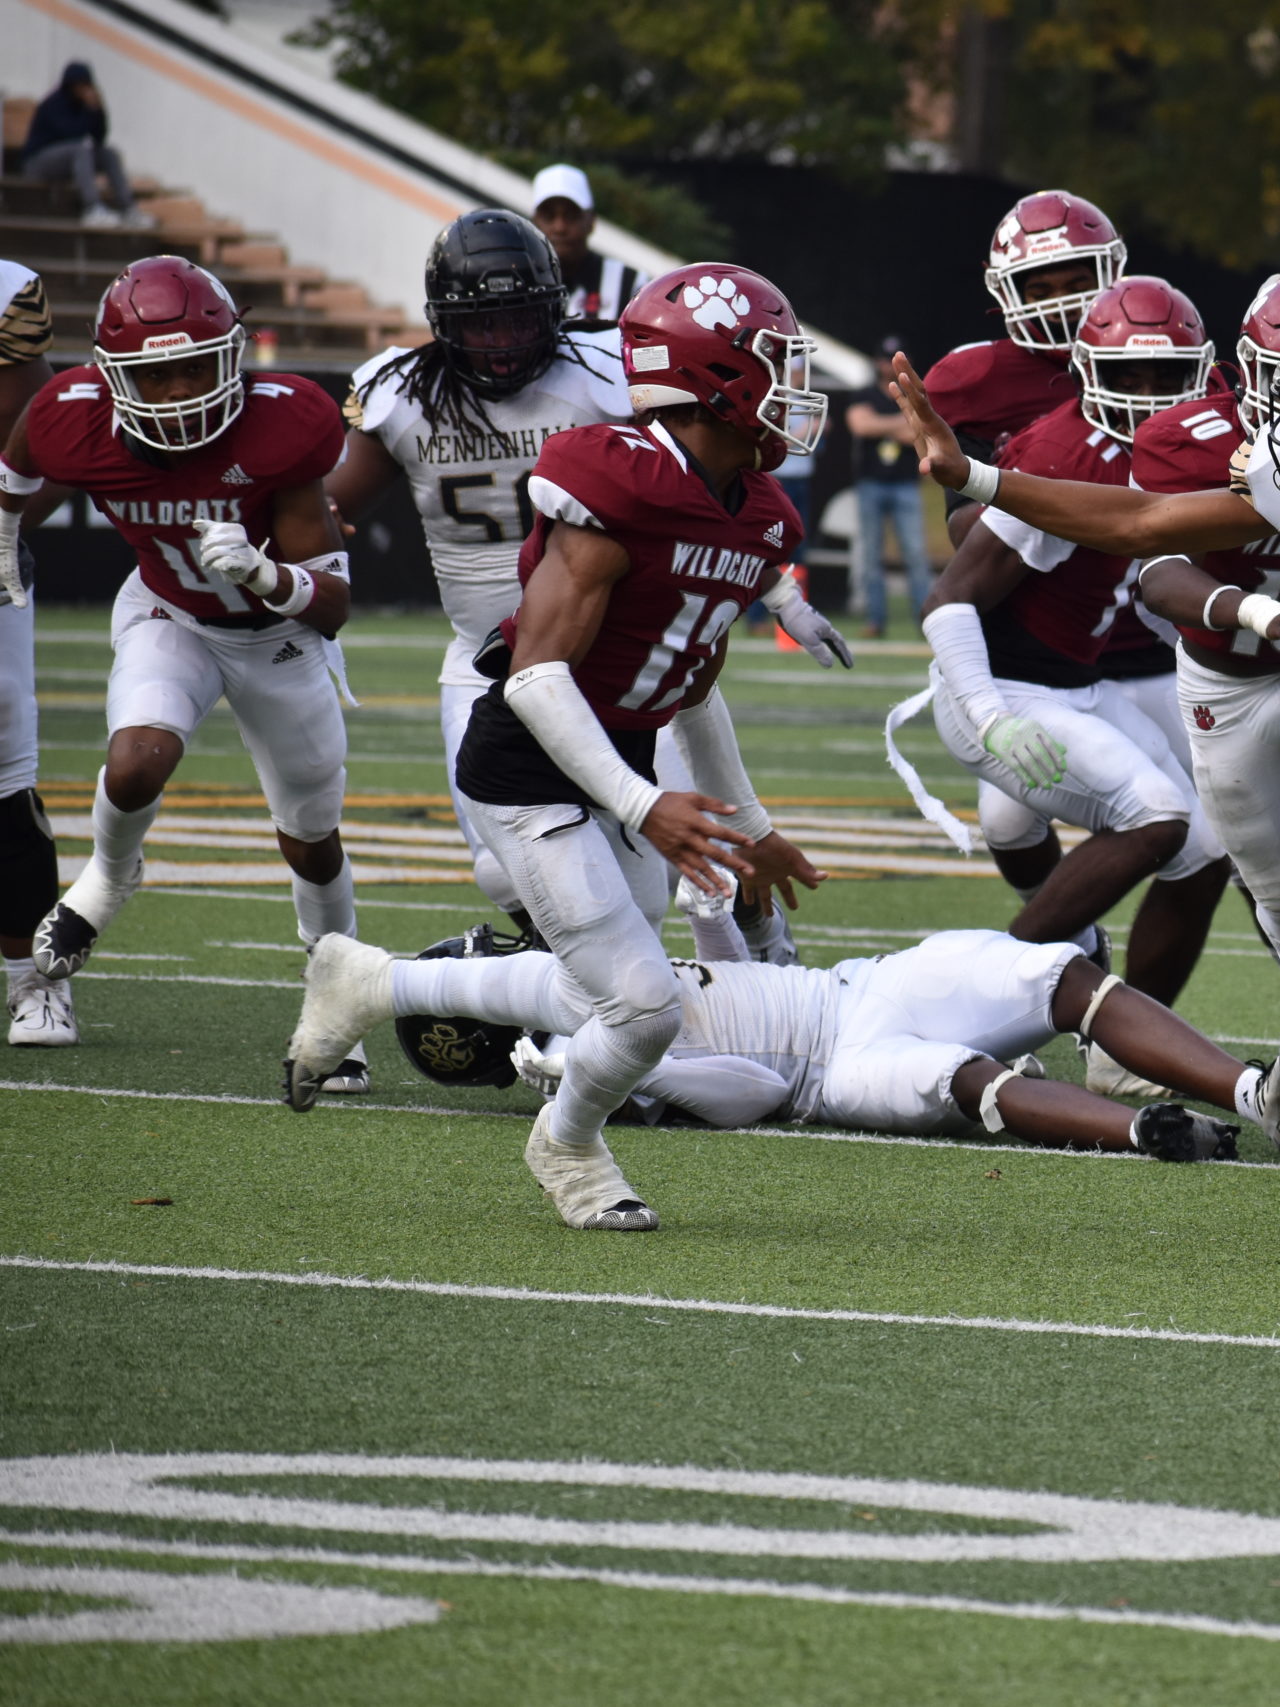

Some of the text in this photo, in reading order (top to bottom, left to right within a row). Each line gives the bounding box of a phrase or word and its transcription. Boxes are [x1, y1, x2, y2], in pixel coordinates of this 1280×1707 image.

[147, 335, 187, 349] Riddell
[1179, 408, 1234, 442] 10
[415, 423, 577, 465] MENDENH
[104, 498, 244, 526] WILDCATS
